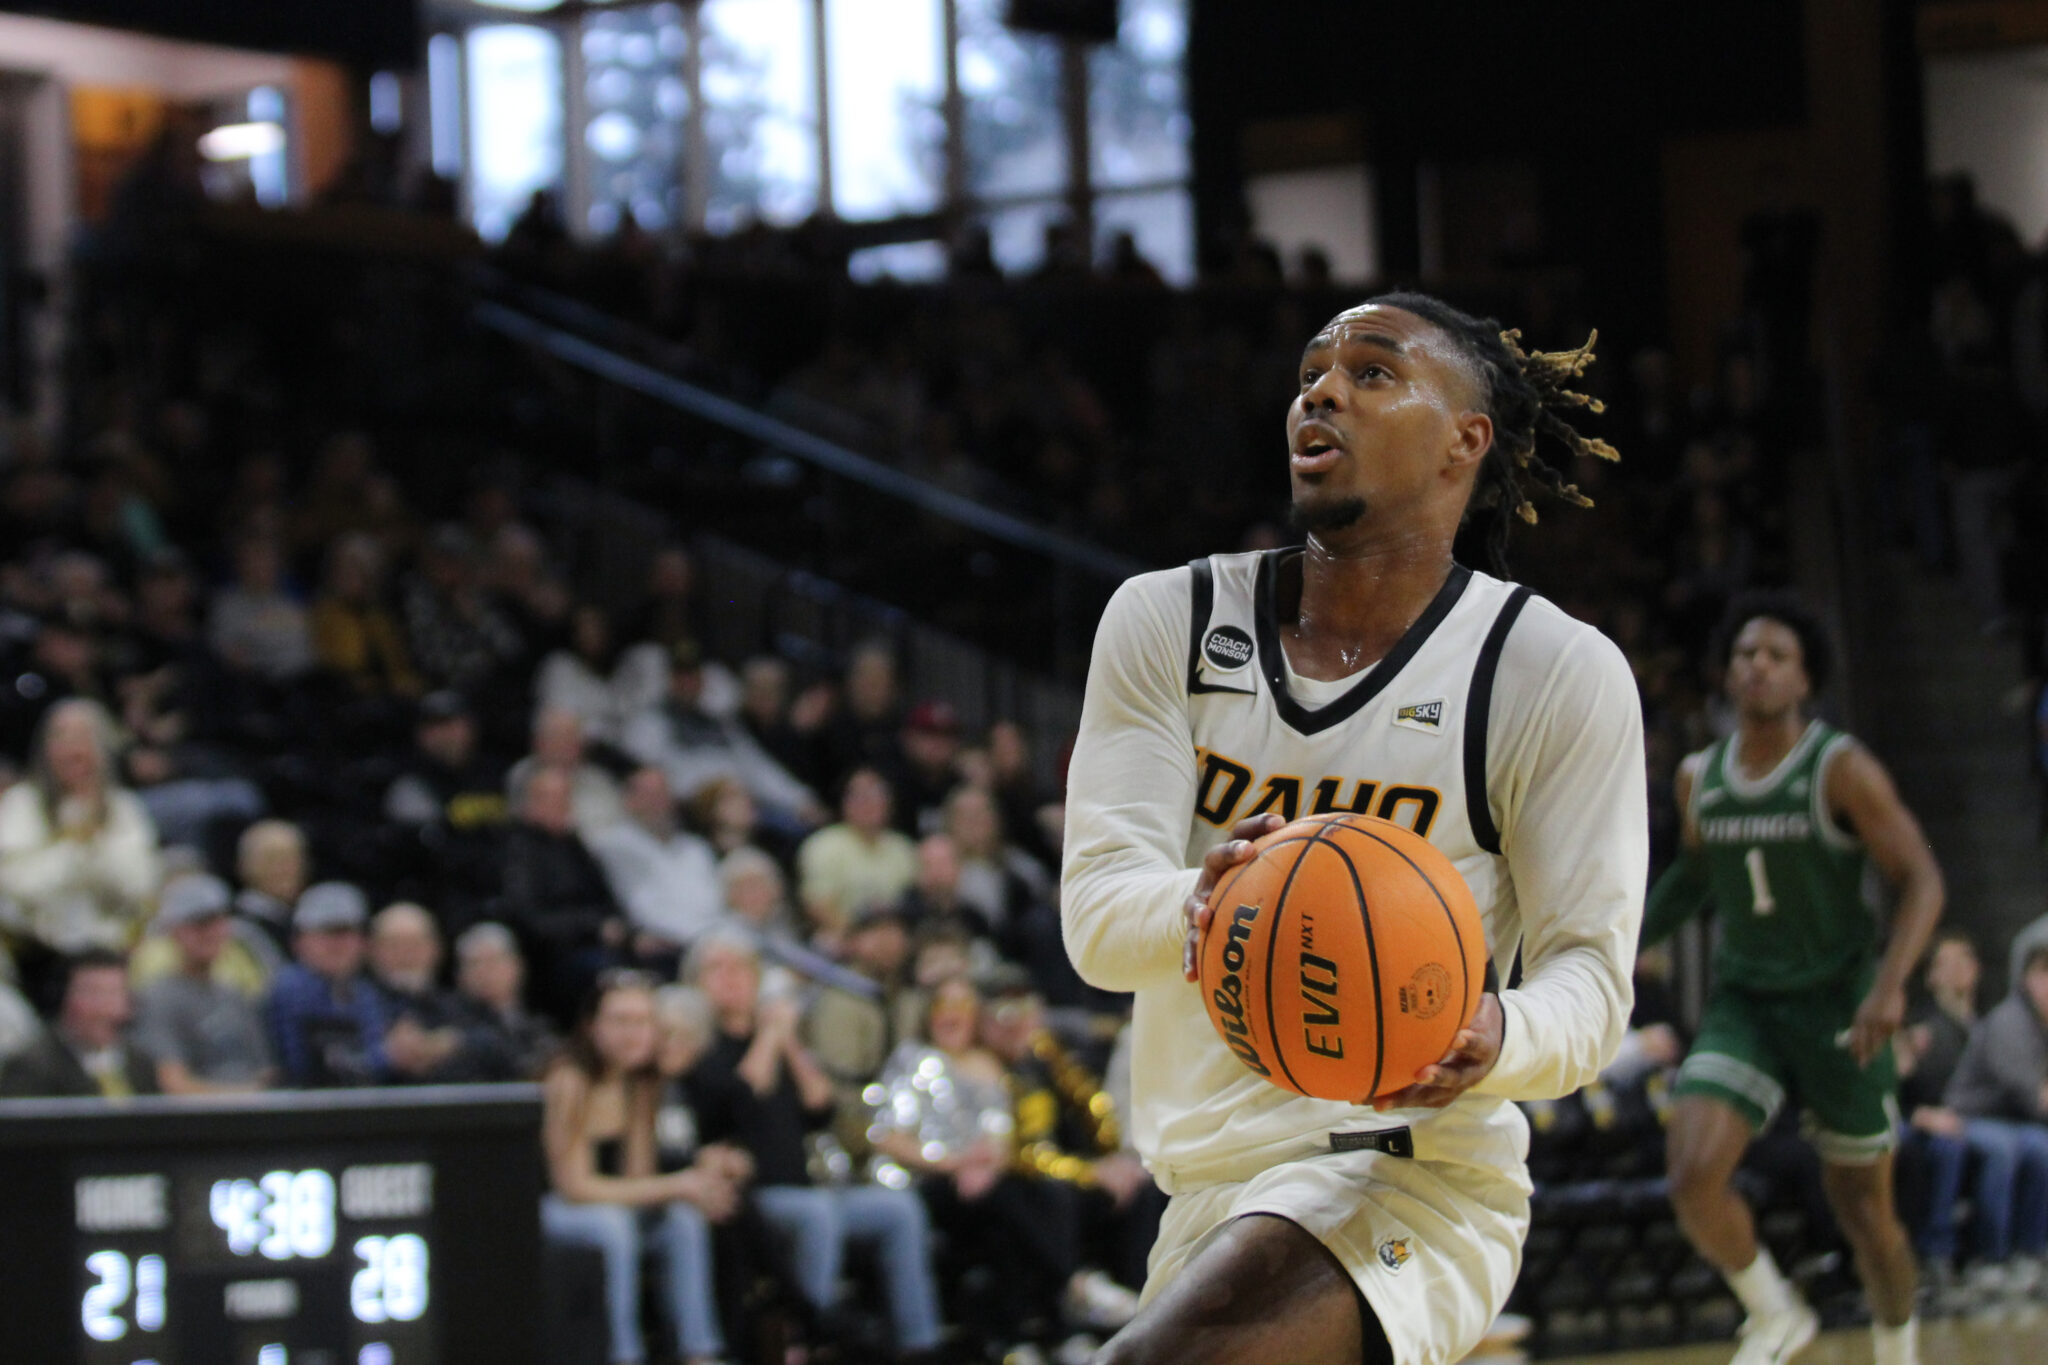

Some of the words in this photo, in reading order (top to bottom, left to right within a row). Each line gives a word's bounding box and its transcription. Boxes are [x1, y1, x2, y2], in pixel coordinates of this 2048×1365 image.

[1207, 642, 1250, 662] MONSON
[1211, 633, 1251, 653] COACH
[1194, 746, 1442, 840] DAHO
[1745, 849, 1776, 916] 1
[1301, 911, 1314, 949] NXT
[1213, 903, 1272, 1077] Wilson
[1300, 951, 1345, 1060] EVO
[1388, 1140, 1400, 1153] L
[81, 1250, 167, 1341] 21
[350, 1233, 429, 1324] 28
